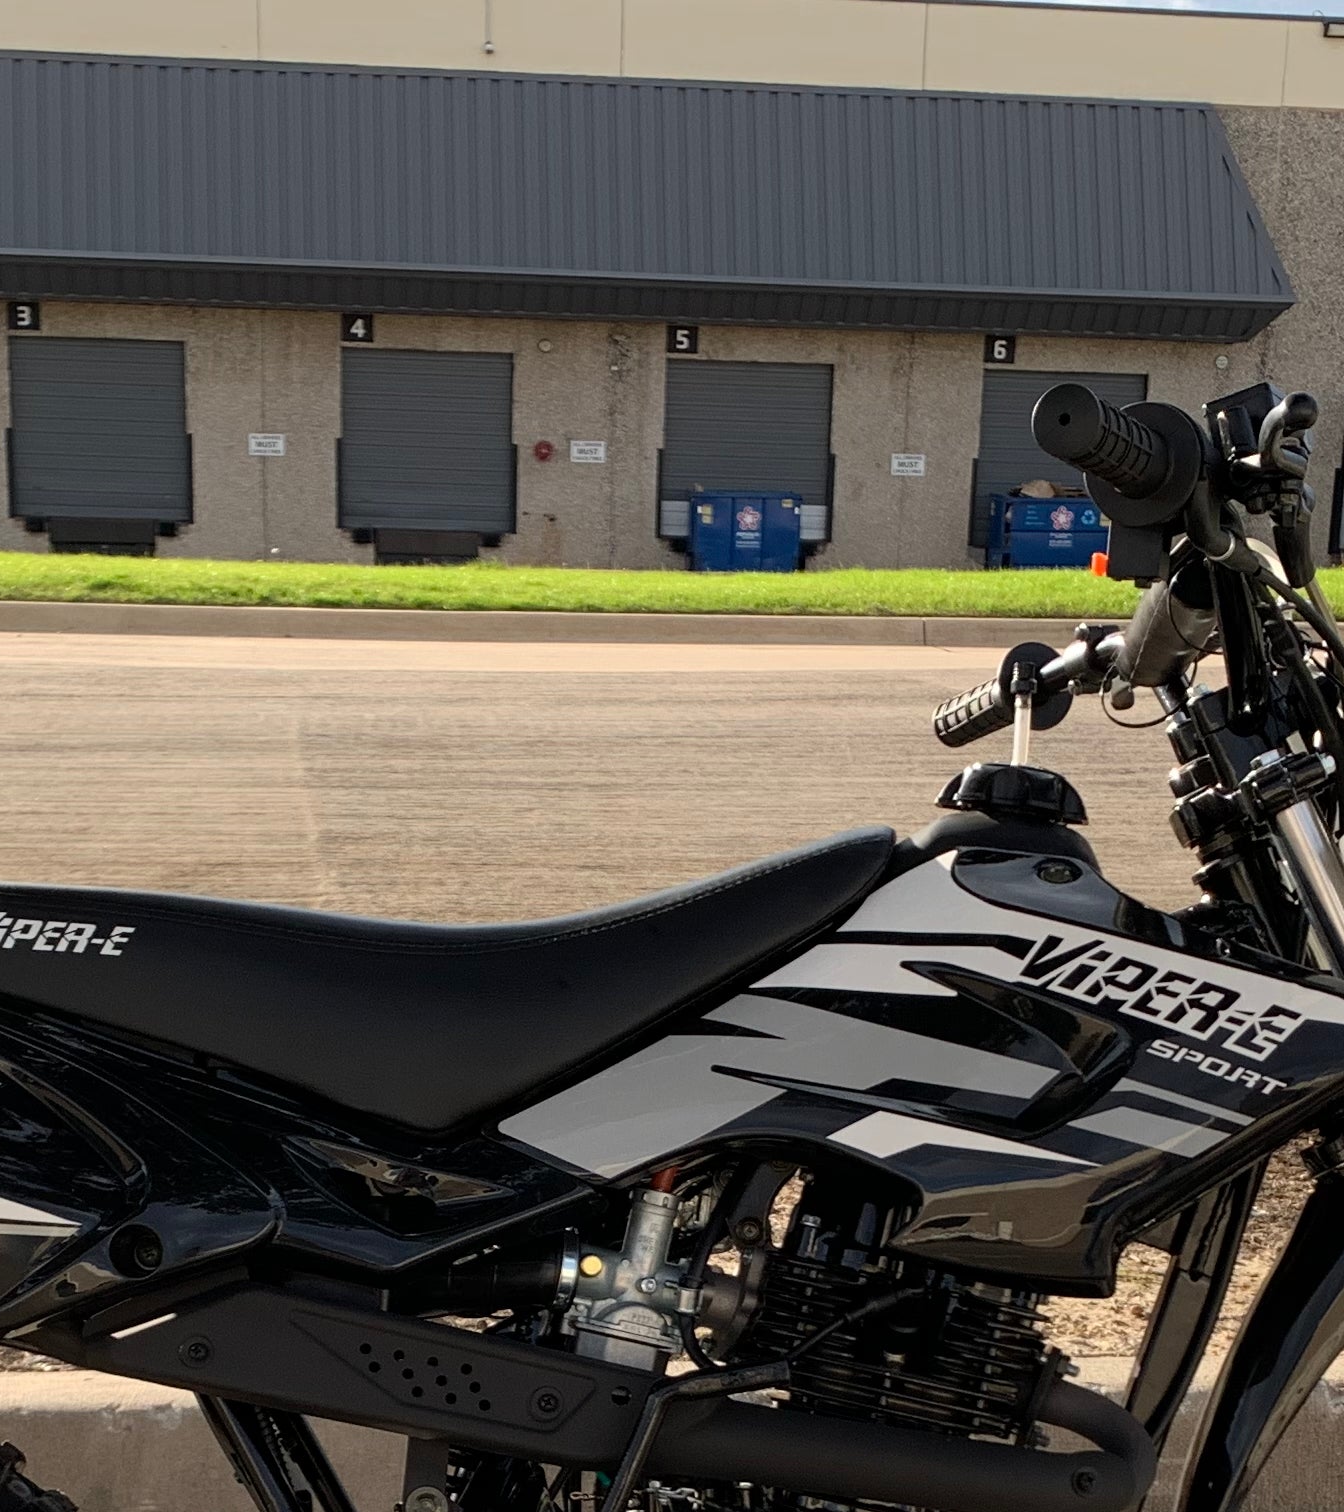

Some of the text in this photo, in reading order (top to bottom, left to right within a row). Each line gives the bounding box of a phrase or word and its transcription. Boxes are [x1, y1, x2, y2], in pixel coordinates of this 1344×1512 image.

[17, 306, 31, 326] 3
[350, 318, 367, 338] 4
[676, 330, 690, 350] 5
[993, 340, 1007, 359] 6
[1146, 1039, 1288, 1096] SPORT
